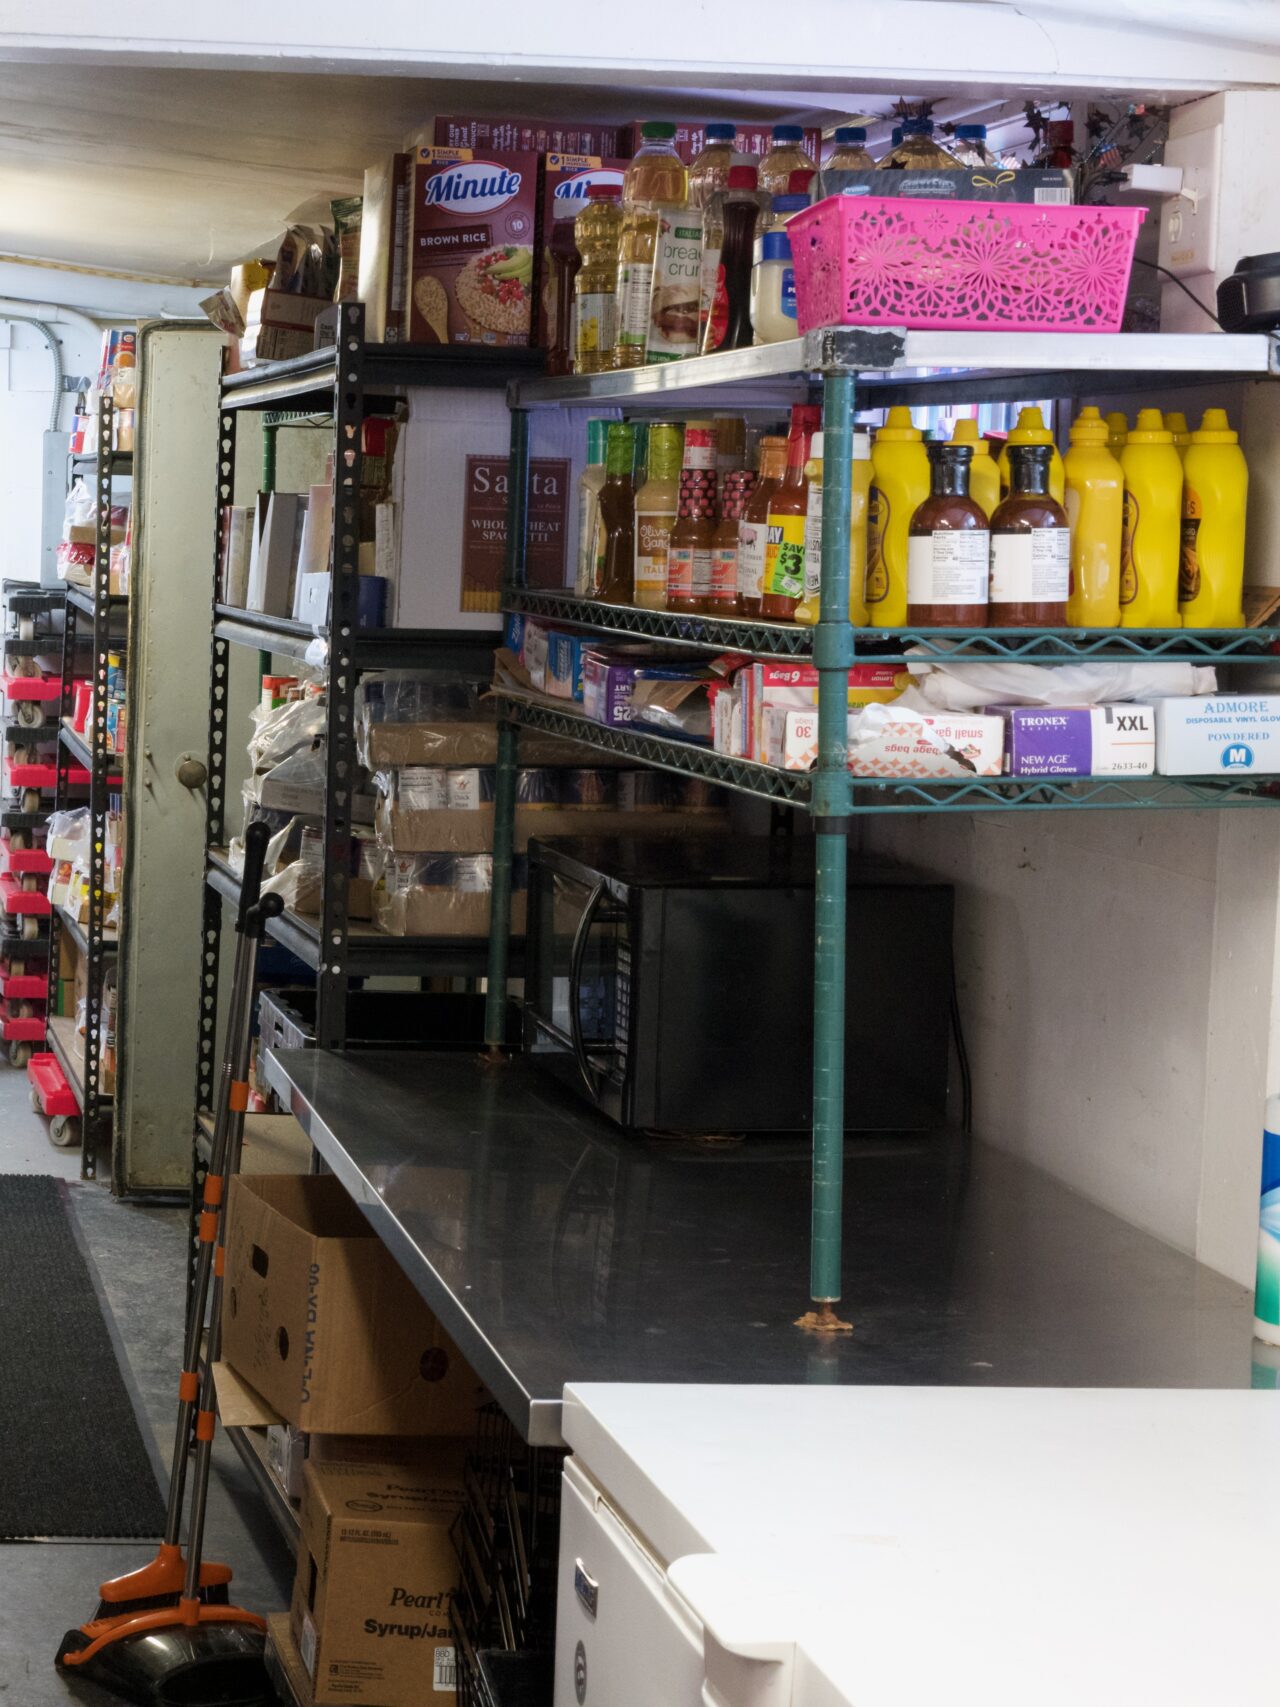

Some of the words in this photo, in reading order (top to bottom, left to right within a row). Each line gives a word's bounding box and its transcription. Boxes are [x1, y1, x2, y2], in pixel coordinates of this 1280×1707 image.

[426, 169, 521, 204] Minute
[512, 220, 523, 230] 10
[677, 229, 702, 238] ITALIA
[420, 235, 460, 247] BROWN
[463, 233, 487, 243] RICE
[473, 467, 559, 496] Sata
[471, 519, 508, 530] WHOL
[528, 521, 561, 532] HEAT
[482, 530, 549, 543] SPATTI
[780, 553, 803, 576] $3
[768, 670, 791, 681] Bags
[791, 670, 801, 683] 6
[613, 706, 631, 721] 25
[1204, 701, 1269, 714] ADMORE
[1019, 716, 1067, 727] TRONEX
[1116, 715, 1149, 732] XXL
[796, 726, 812, 738] 30
[954, 729, 984, 740] small
[1207, 732, 1270, 741] POWDERED
[883, 744, 910, 755] bags
[1021, 755, 1046, 765] NEW
[1047, 754, 1068, 764] AGE
[1020, 765, 1048, 776] Hybrid
[1049, 766, 1077, 774] Gloves
[1111, 762, 1148, 771] 2633-40
[389, 1587, 444, 1609] Pearl
